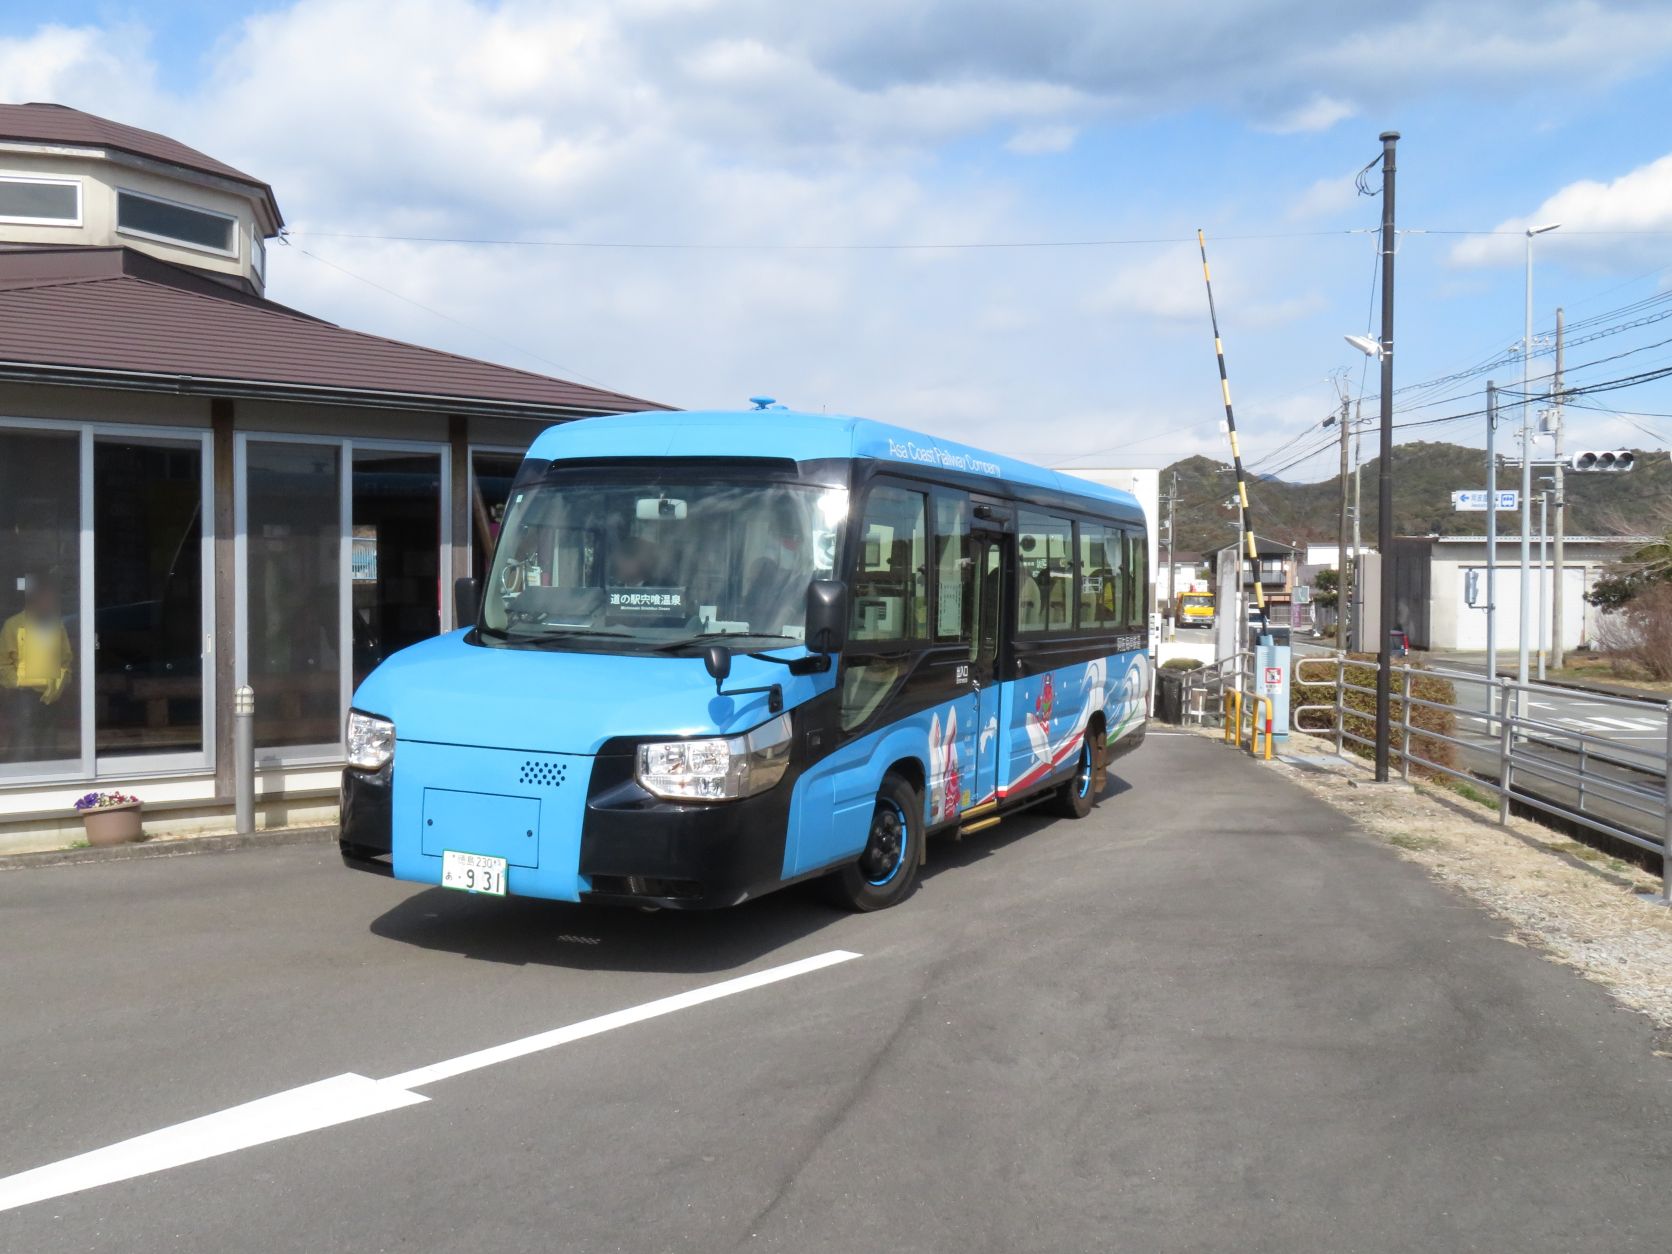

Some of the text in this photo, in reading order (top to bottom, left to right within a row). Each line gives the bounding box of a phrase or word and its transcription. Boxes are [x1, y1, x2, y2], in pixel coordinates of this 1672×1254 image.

[889, 438, 908, 459] Asa
[907, 441, 936, 463] Coast
[610, 594, 681, 606] 道の駅宍喰温泉
